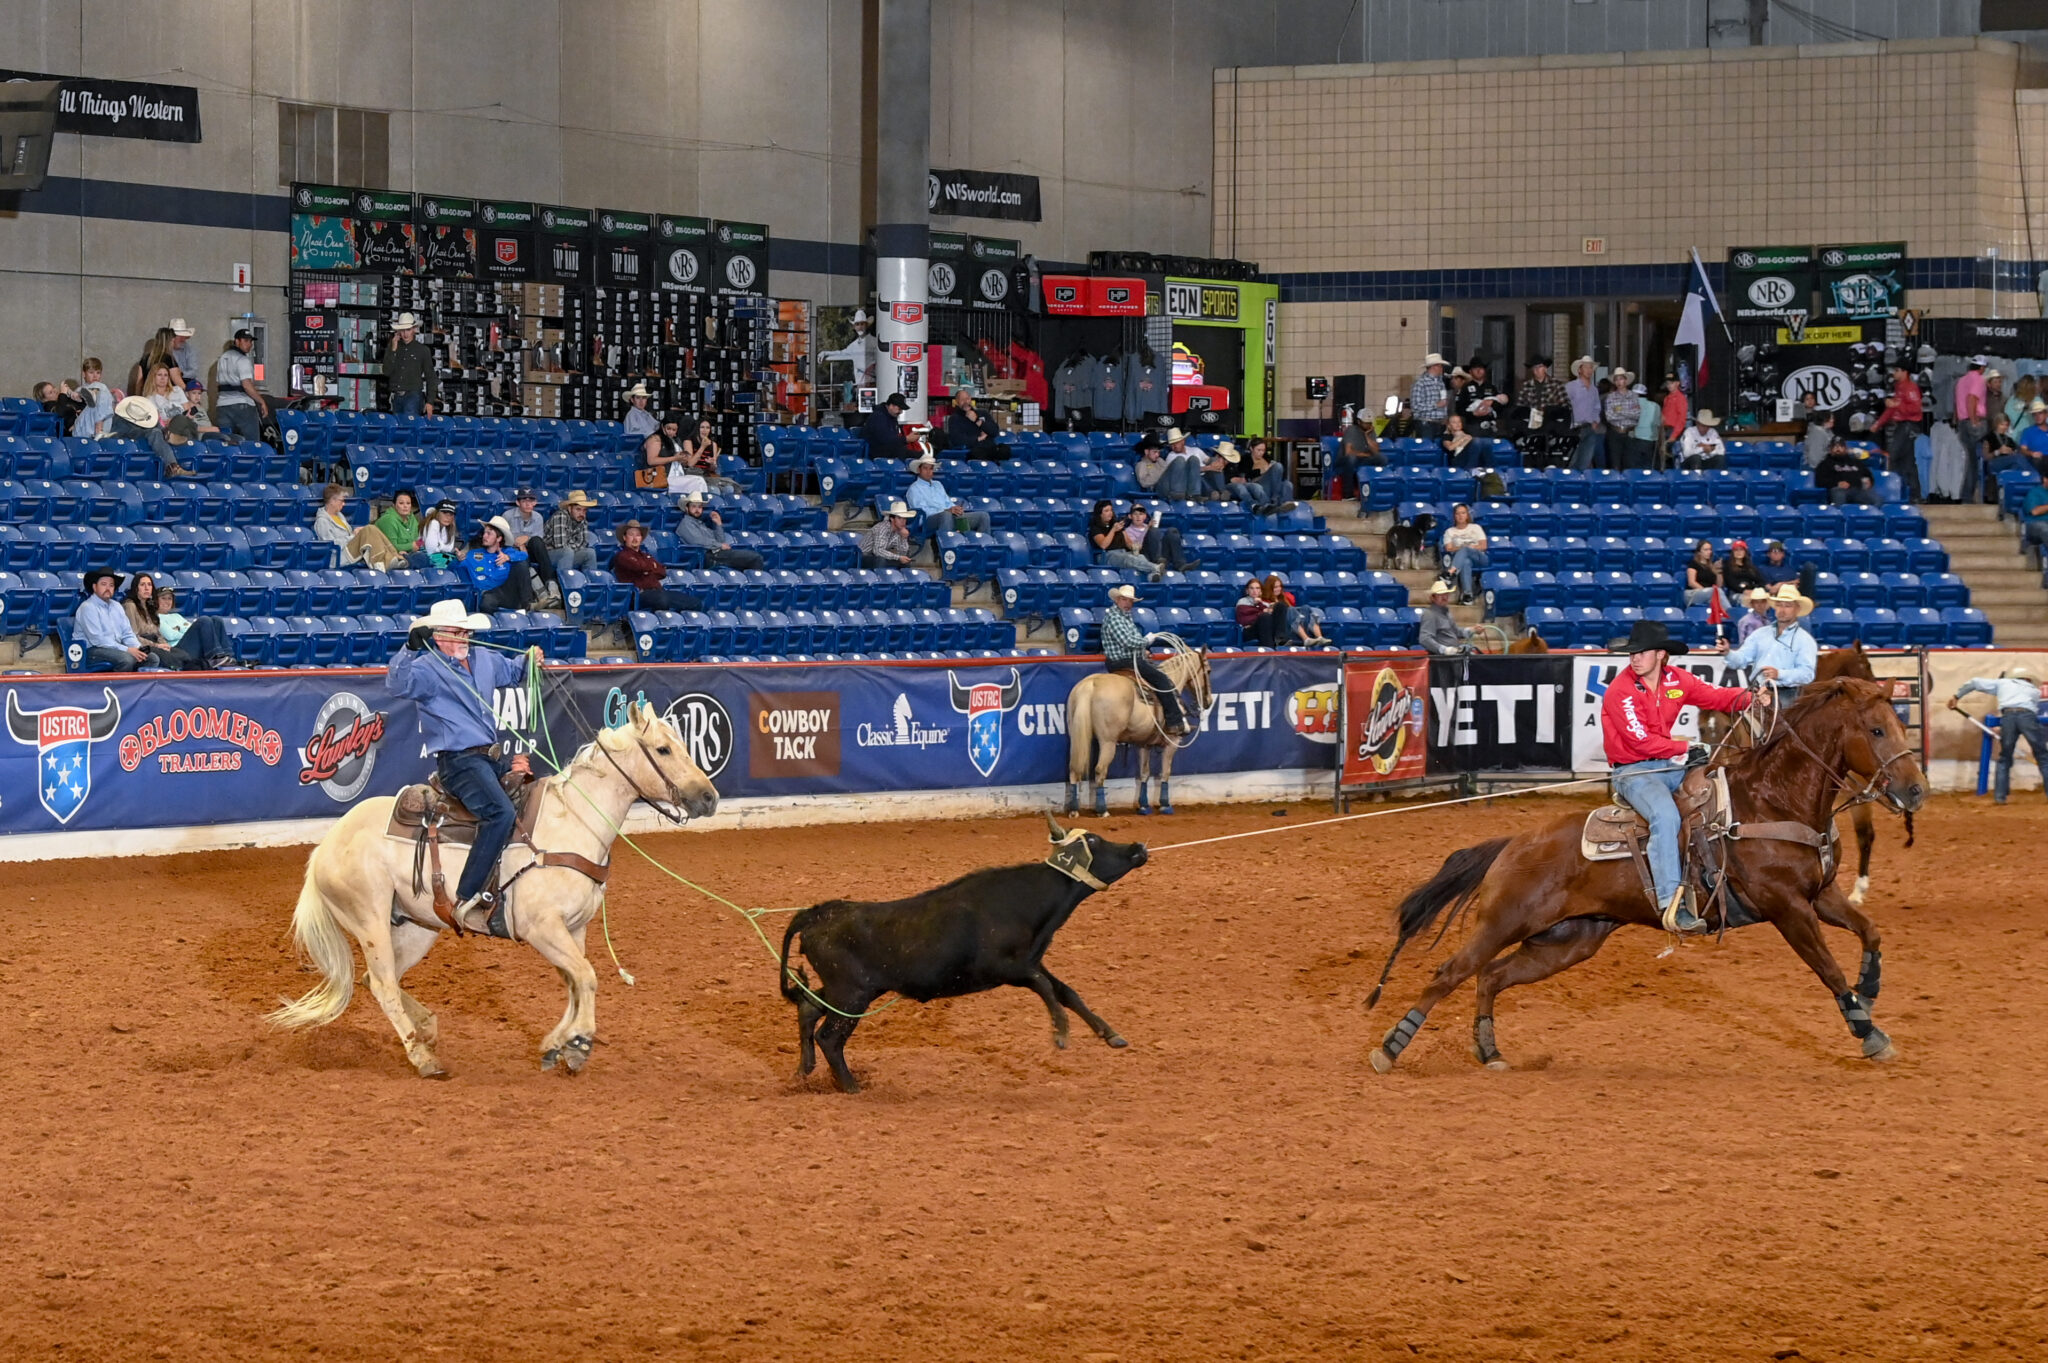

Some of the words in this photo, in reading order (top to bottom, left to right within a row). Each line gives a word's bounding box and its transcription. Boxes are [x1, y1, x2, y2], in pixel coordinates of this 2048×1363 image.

[79, 91, 127, 122] Things
[129, 95, 183, 122] Western
[674, 253, 694, 278] NRS
[1738, 253, 1754, 266] NRS
[1758, 256, 1809, 264] 800-GO-ROPIN
[1826, 251, 1844, 264] NRS
[1848, 253, 1901, 261] 800-GO-ROPIN
[731, 259, 751, 283] NRS
[932, 267, 951, 290] NRS
[662, 282, 706, 293] NRSworld.com
[985, 273, 1004, 296] NRS
[1756, 281, 1787, 303] NRS
[897, 306, 919, 319] HP
[1169, 287, 1198, 316] EQN
[1202, 290, 1236, 316] SPORTS
[1737, 308, 1807, 317] NRSworld.com
[1831, 331, 1852, 339] HERE
[1976, 327, 1993, 336] NRS
[1994, 327, 2017, 337] GEAR
[897, 346, 919, 358] HP
[1794, 371, 1840, 406] NRS
[604, 686, 648, 729] Git
[971, 690, 999, 707] USTRC
[317, 696, 365, 731] GENUINE
[758, 709, 831, 733] COWBOY
[1017, 703, 1067, 736] CIN
[1200, 691, 1271, 732] YETI
[1430, 684, 1556, 747] YETI
[42, 716, 86, 737] USTRC
[138, 707, 264, 757] BLOOMER
[671, 702, 721, 771] NRS
[857, 722, 894, 747] Classic
[911, 722, 948, 750] Equine
[300, 712, 384, 782] Lawley's
[773, 736, 816, 760] TACK
[158, 751, 242, 773] TRAILERS
